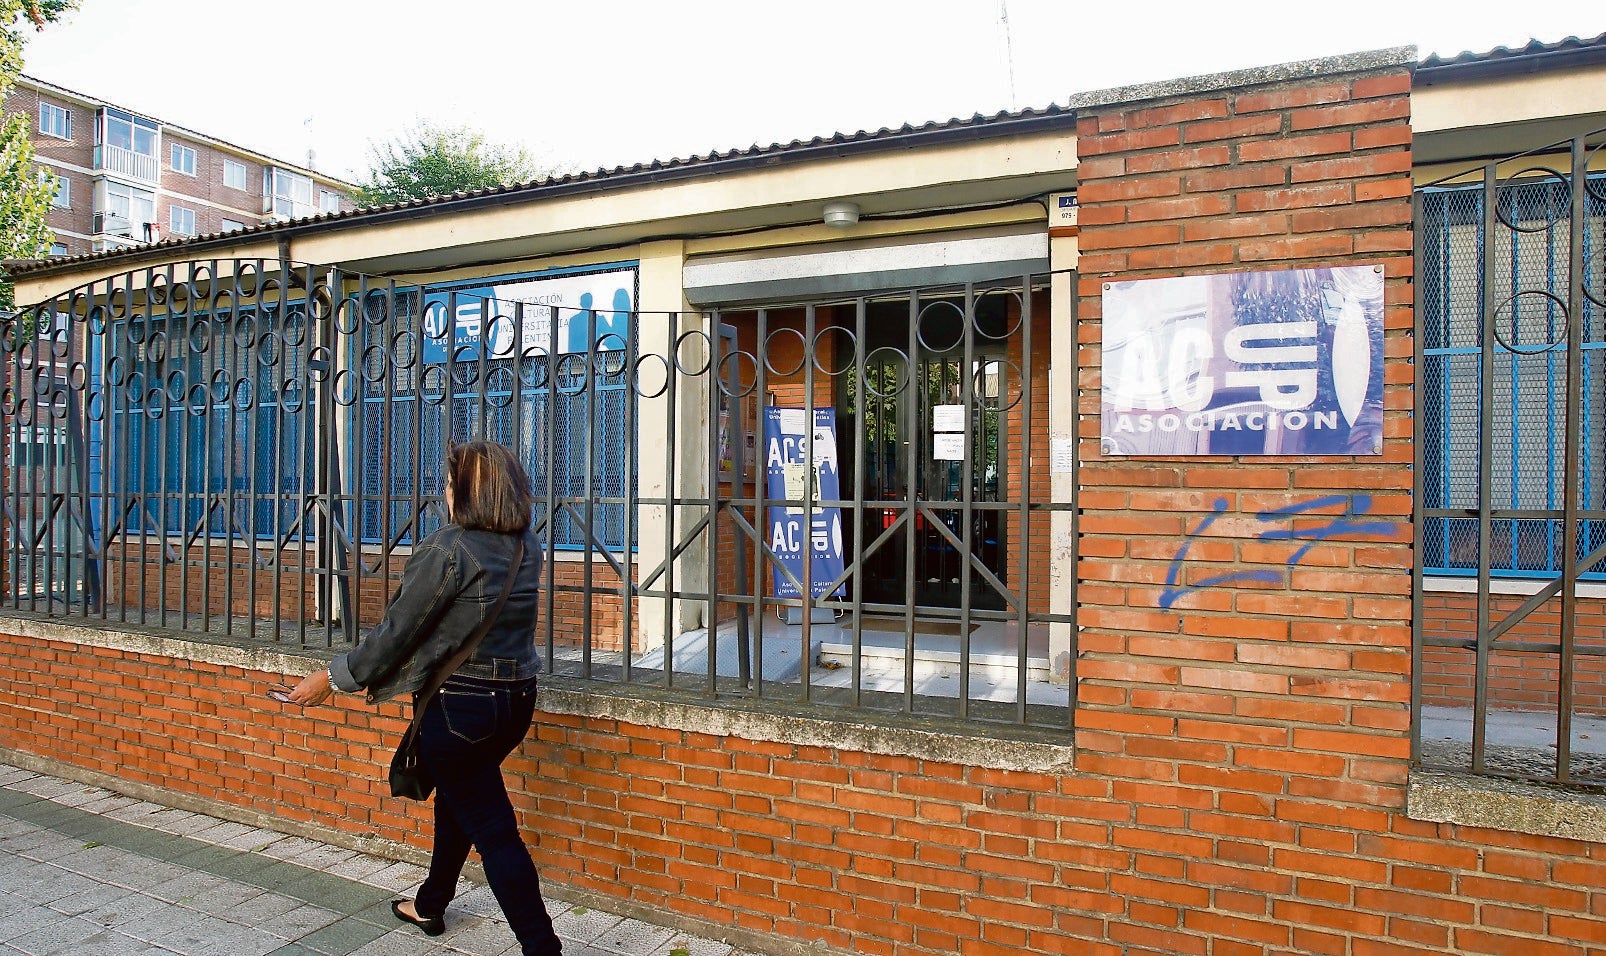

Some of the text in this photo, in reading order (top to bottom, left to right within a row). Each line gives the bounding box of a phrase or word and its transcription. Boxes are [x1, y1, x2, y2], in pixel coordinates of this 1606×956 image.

[499, 318, 569, 334] UNIRSITAIA
[432, 335, 482, 346] ASOIACIO
[1113, 320, 1318, 413] AC UP
[1114, 411, 1338, 433] ASOCIACION
[771, 520, 800, 553] AC
